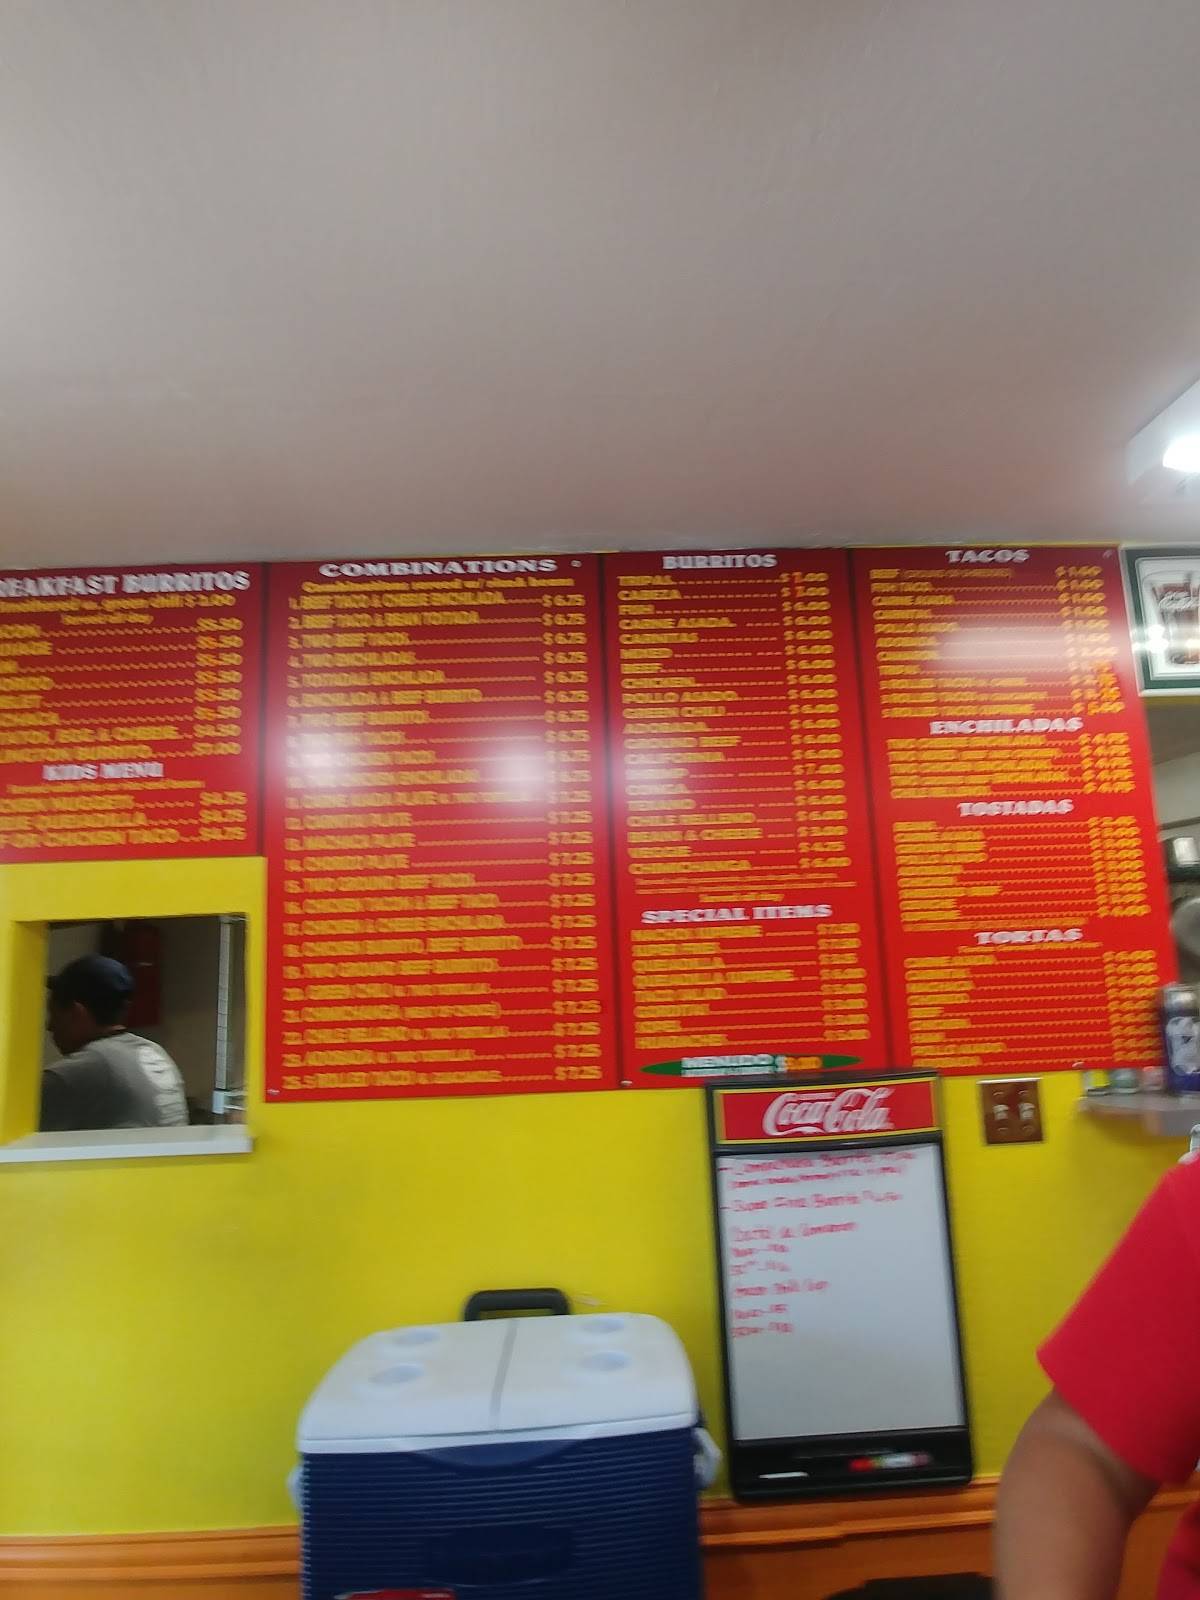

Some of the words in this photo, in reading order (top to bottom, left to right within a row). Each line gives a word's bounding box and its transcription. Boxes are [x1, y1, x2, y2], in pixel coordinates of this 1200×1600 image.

[662, 554, 778, 569] BURRITOS
[945, 550, 1030, 563] TACOS
[319, 559, 558, 577] COMBINATIONS
[122, 571, 250, 593] BURRITOS
[929, 716, 1084, 735] ENCHILADAS
[43, 765, 97, 781] KIDS
[100, 763, 163, 778] MENU
[956, 799, 1074, 817] TOSTADAS
[641, 908, 750, 924] SPECIAL
[752, 904, 833, 920] ITEMS
[974, 928, 1083, 945] TORTAS
